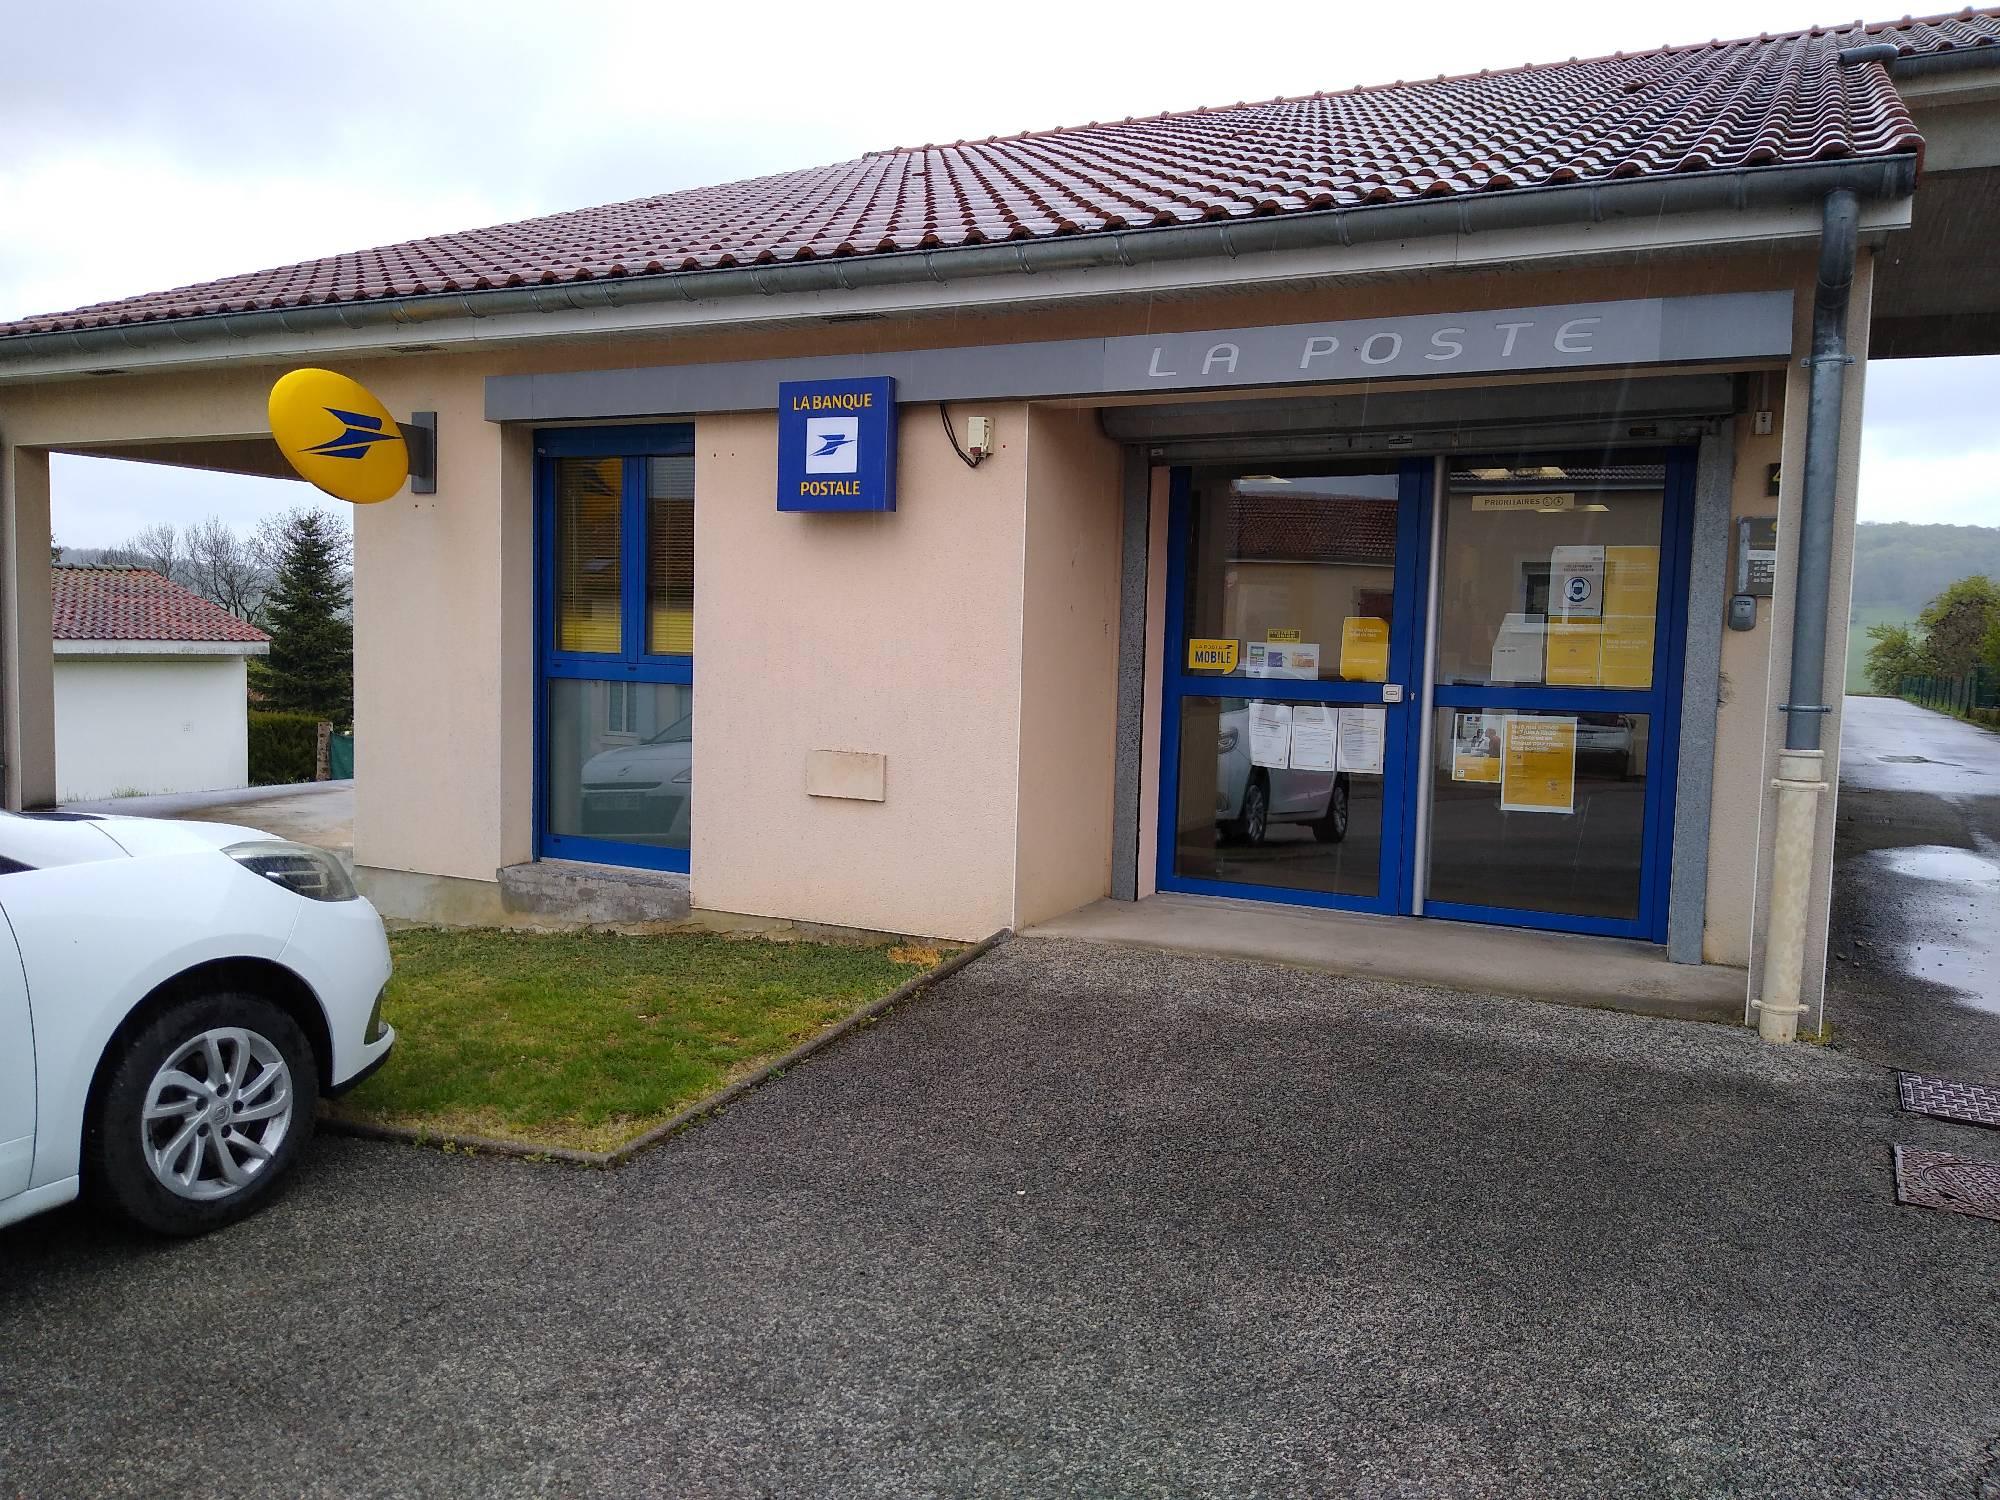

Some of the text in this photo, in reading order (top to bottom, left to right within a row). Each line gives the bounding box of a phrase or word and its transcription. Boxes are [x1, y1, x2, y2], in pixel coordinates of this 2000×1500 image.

[1148, 317, 1601, 377] LA POSTE
[793, 393, 873, 411] LA BANQUE
[800, 480, 861, 496] POSTALE
[1195, 650, 1232, 664] MOBILE
